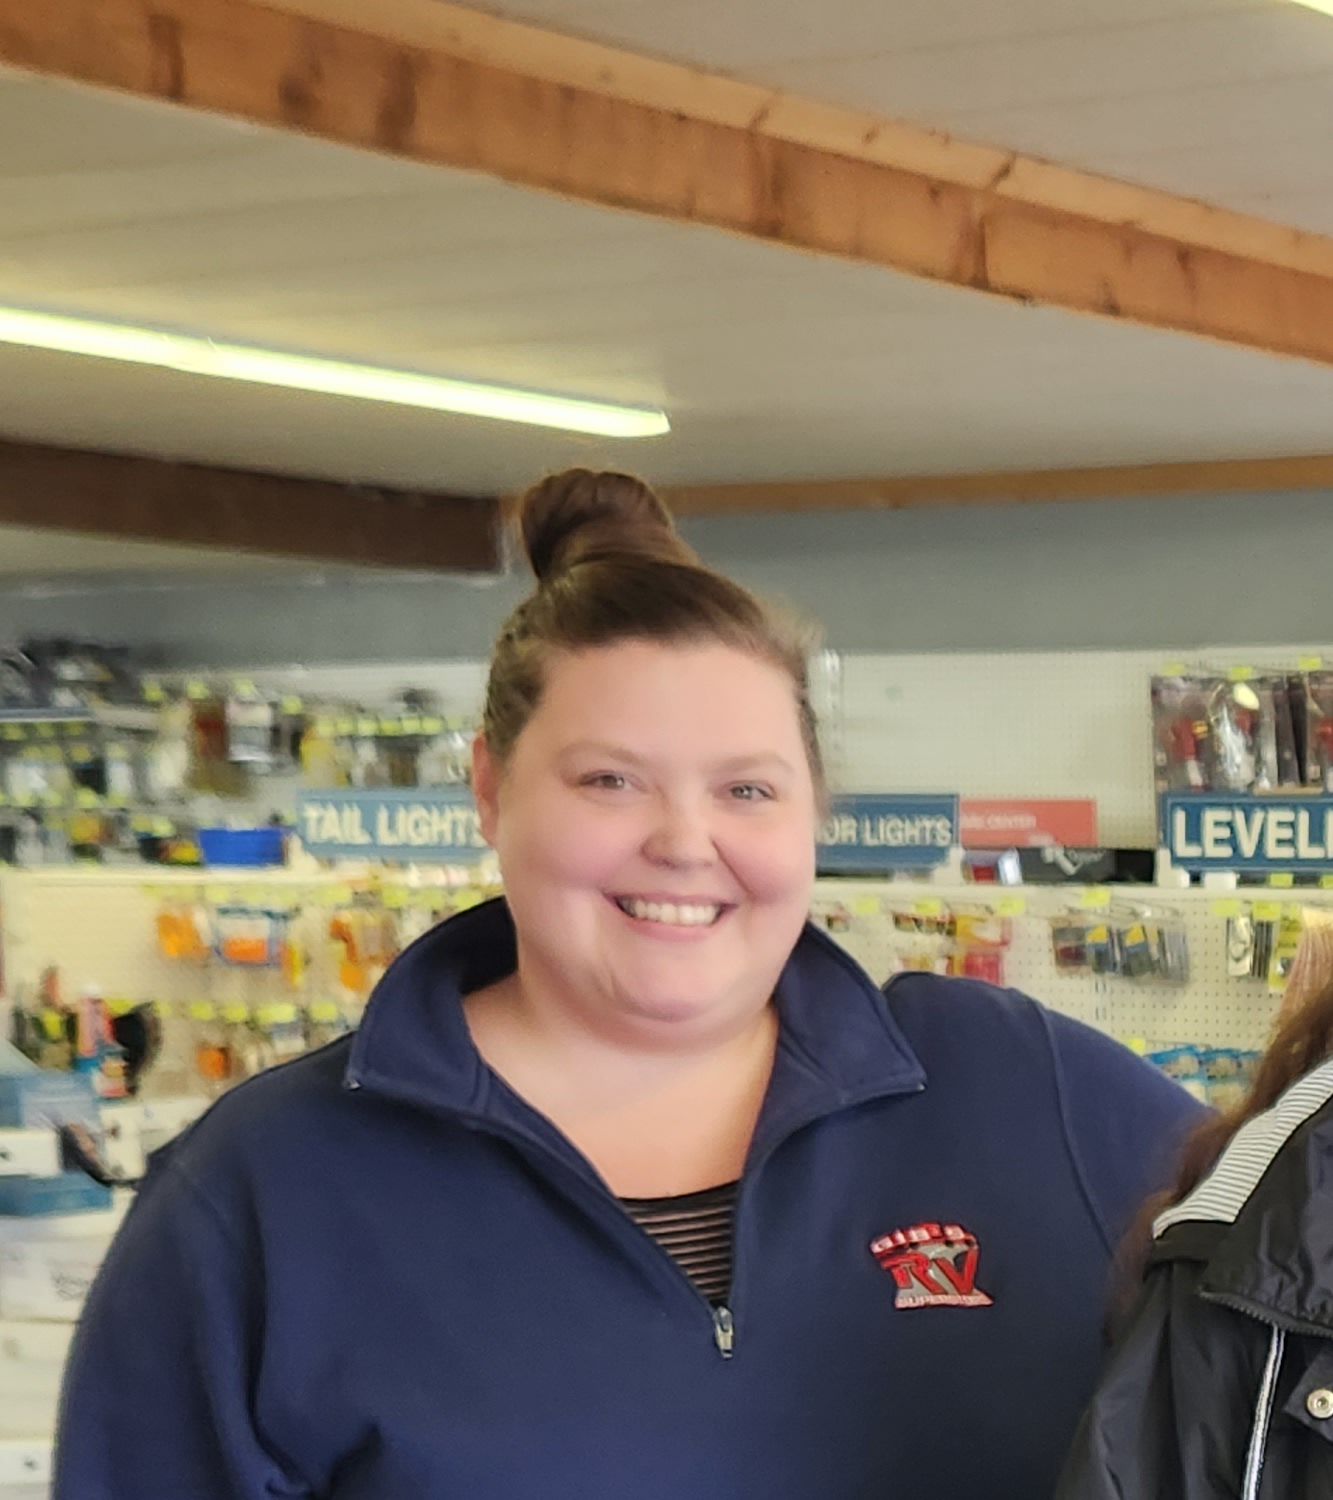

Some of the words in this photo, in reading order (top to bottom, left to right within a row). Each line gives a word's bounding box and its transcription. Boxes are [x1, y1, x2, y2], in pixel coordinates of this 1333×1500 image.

[303, 803, 373, 845] TAIL
[376, 804, 489, 847] LIGHTS
[862, 815, 951, 845] LIGHTS
[881, 1250, 977, 1295] RV
